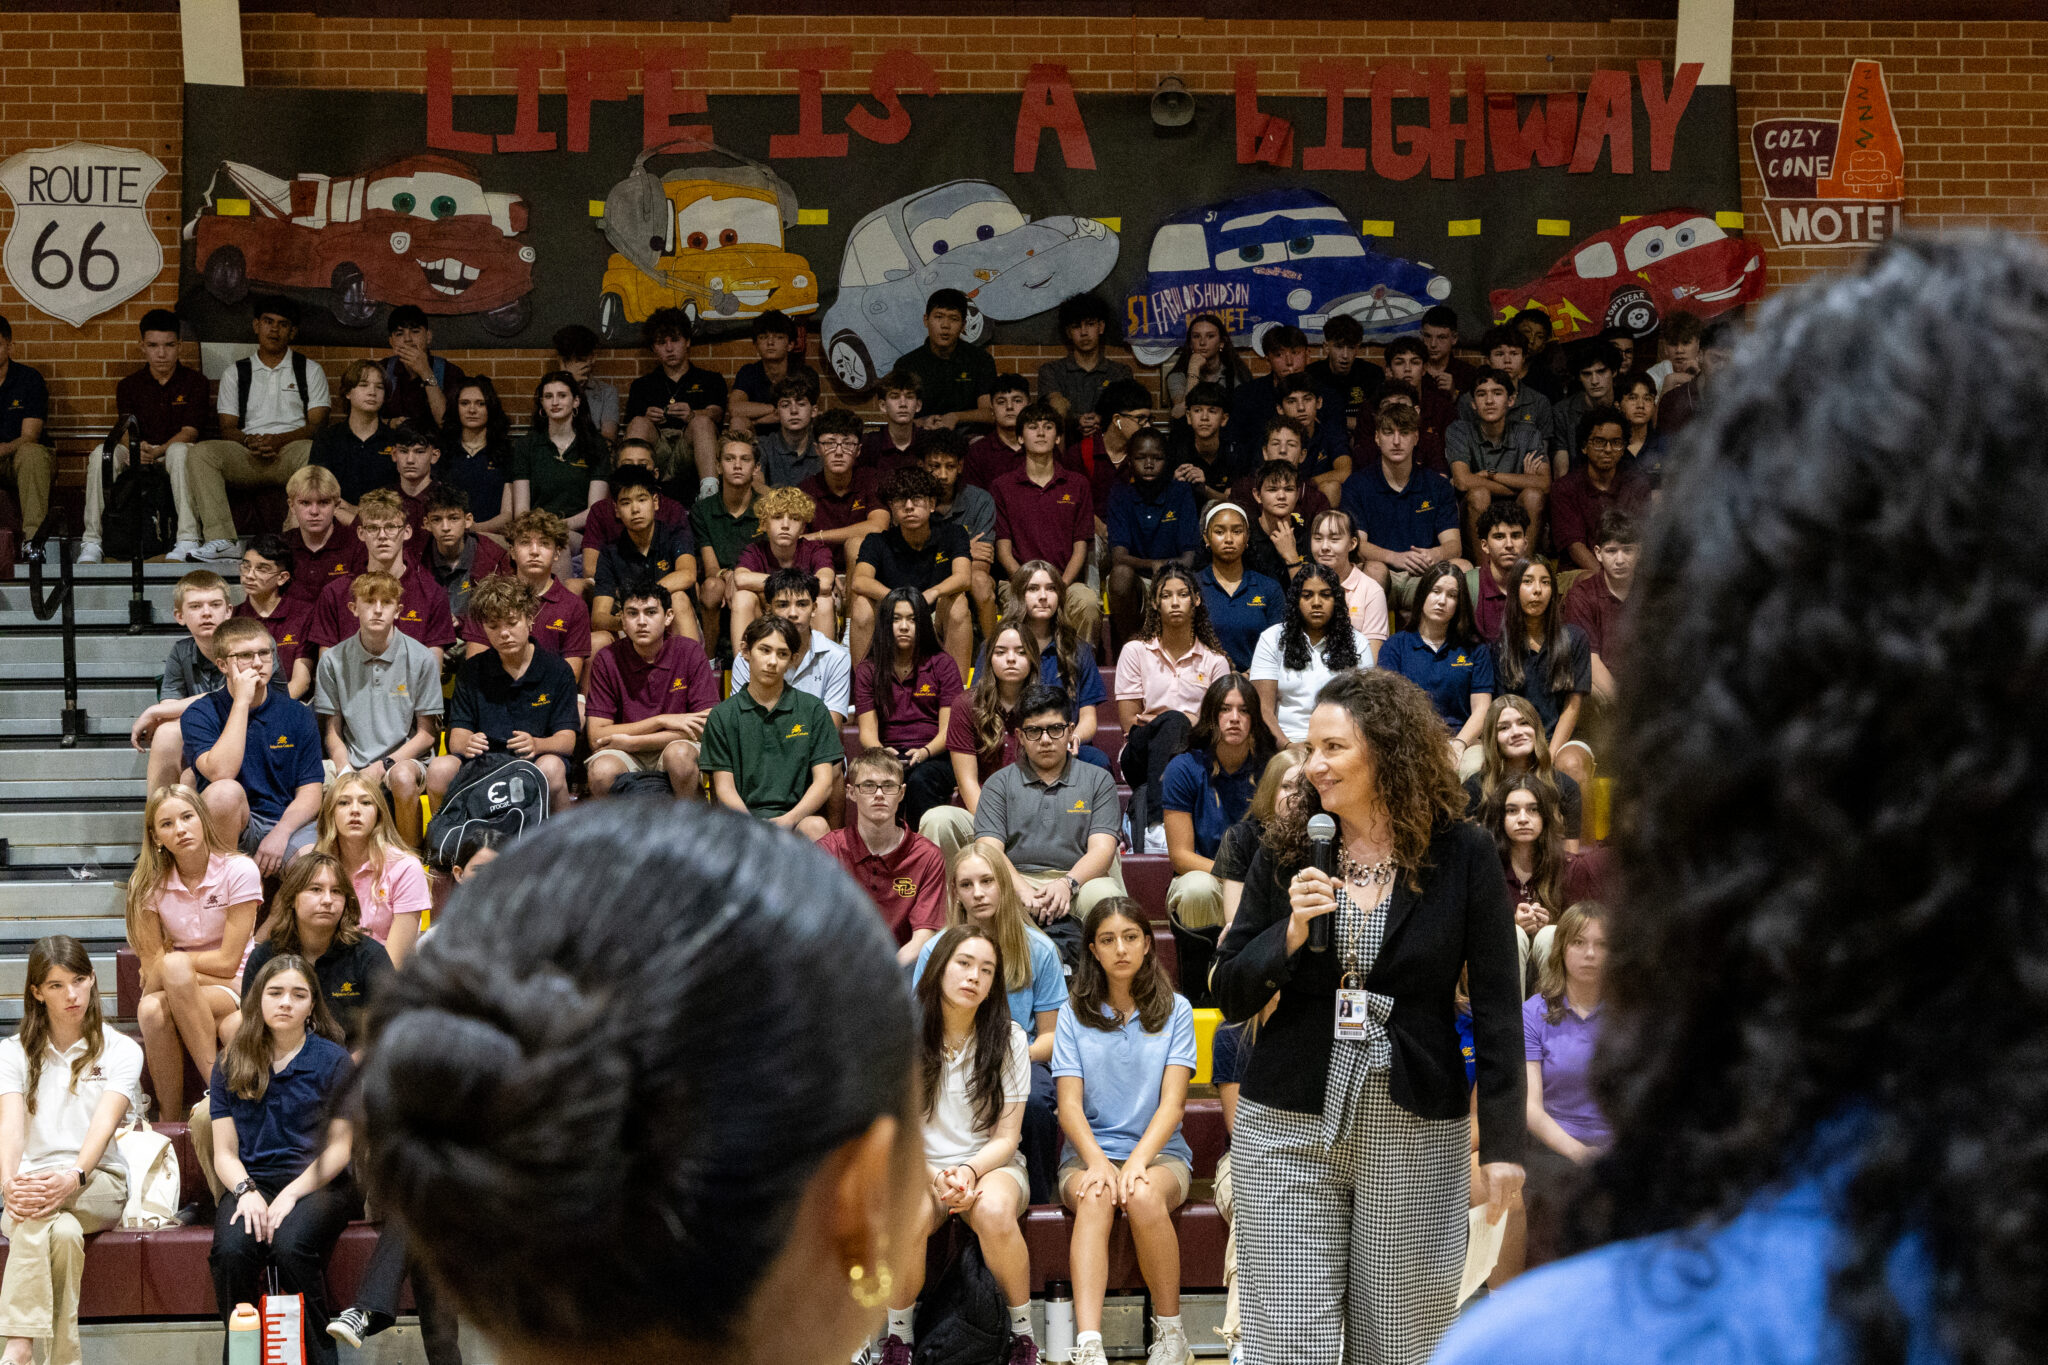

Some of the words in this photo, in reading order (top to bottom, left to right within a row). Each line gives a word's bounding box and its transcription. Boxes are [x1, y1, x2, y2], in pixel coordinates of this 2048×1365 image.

[427, 47, 714, 154] LIFE
[764, 46, 940, 158] IS
[1014, 63, 1097, 173] A
[1235, 59, 1705, 181] HIGHWAY
[1764, 128, 1822, 150] COZY
[29, 166, 141, 203] ROUTE
[1768, 156, 1830, 178] CONE
[1204, 211, 1218, 223] 51
[31, 220, 119, 292] 66
[1151, 284, 1205, 335] FABULOUS
[1204, 282, 1250, 307] HUDSON
